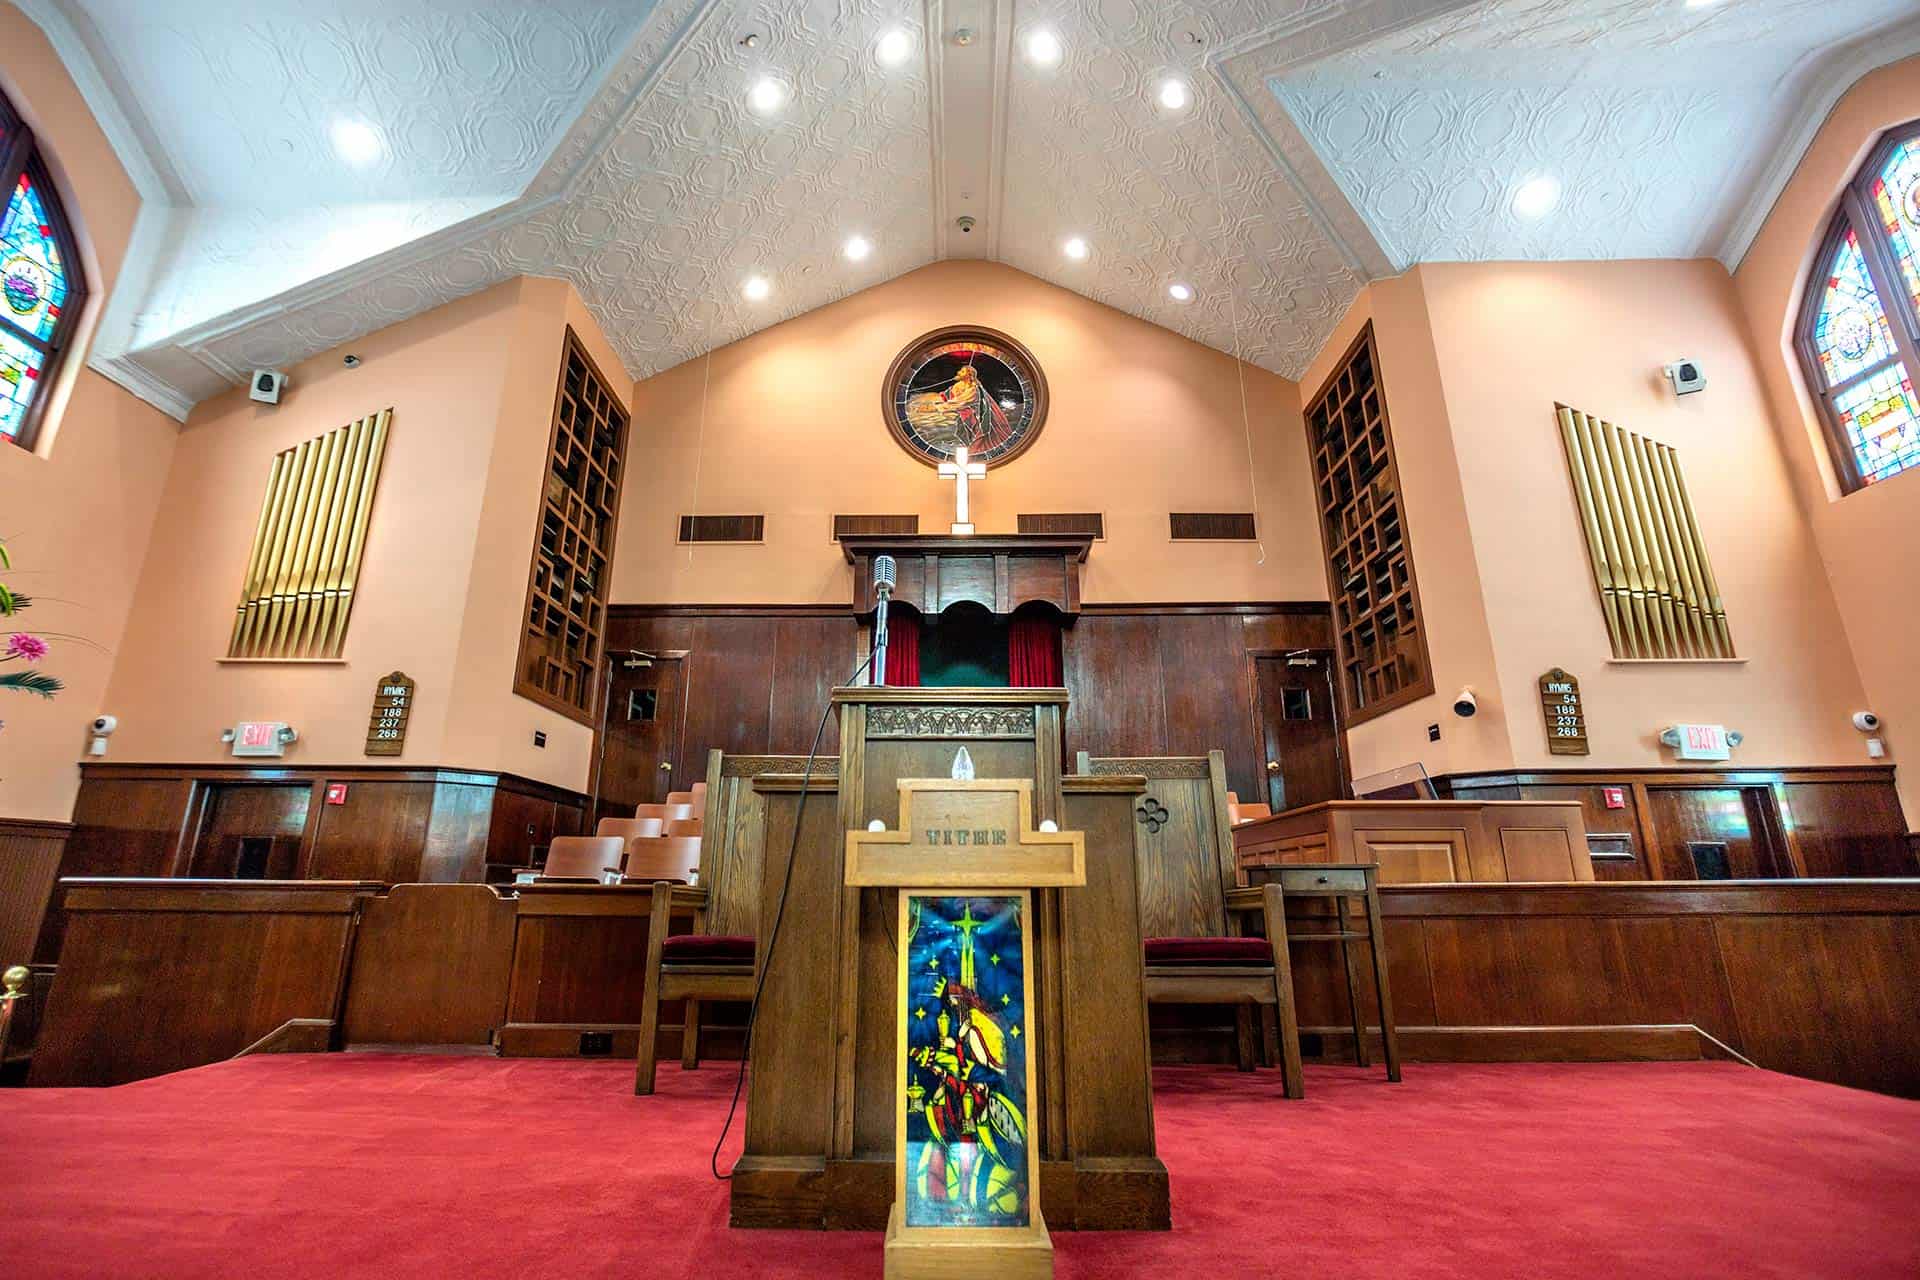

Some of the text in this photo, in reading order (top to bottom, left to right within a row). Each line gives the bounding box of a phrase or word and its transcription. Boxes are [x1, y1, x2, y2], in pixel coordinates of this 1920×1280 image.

[391, 697, 405, 707] 54
[1563, 694, 1577, 704] 54
[383, 708, 402, 718] 188
[1556, 705, 1576, 715] 188
[379, 718, 400, 728] 237
[1557, 716, 1577, 726] 237
[242, 724, 274, 745] EXIT
[1557, 727, 1578, 737] 268
[1687, 726, 1718, 750] EXIT
[926, 829, 1007, 846] TITHE
